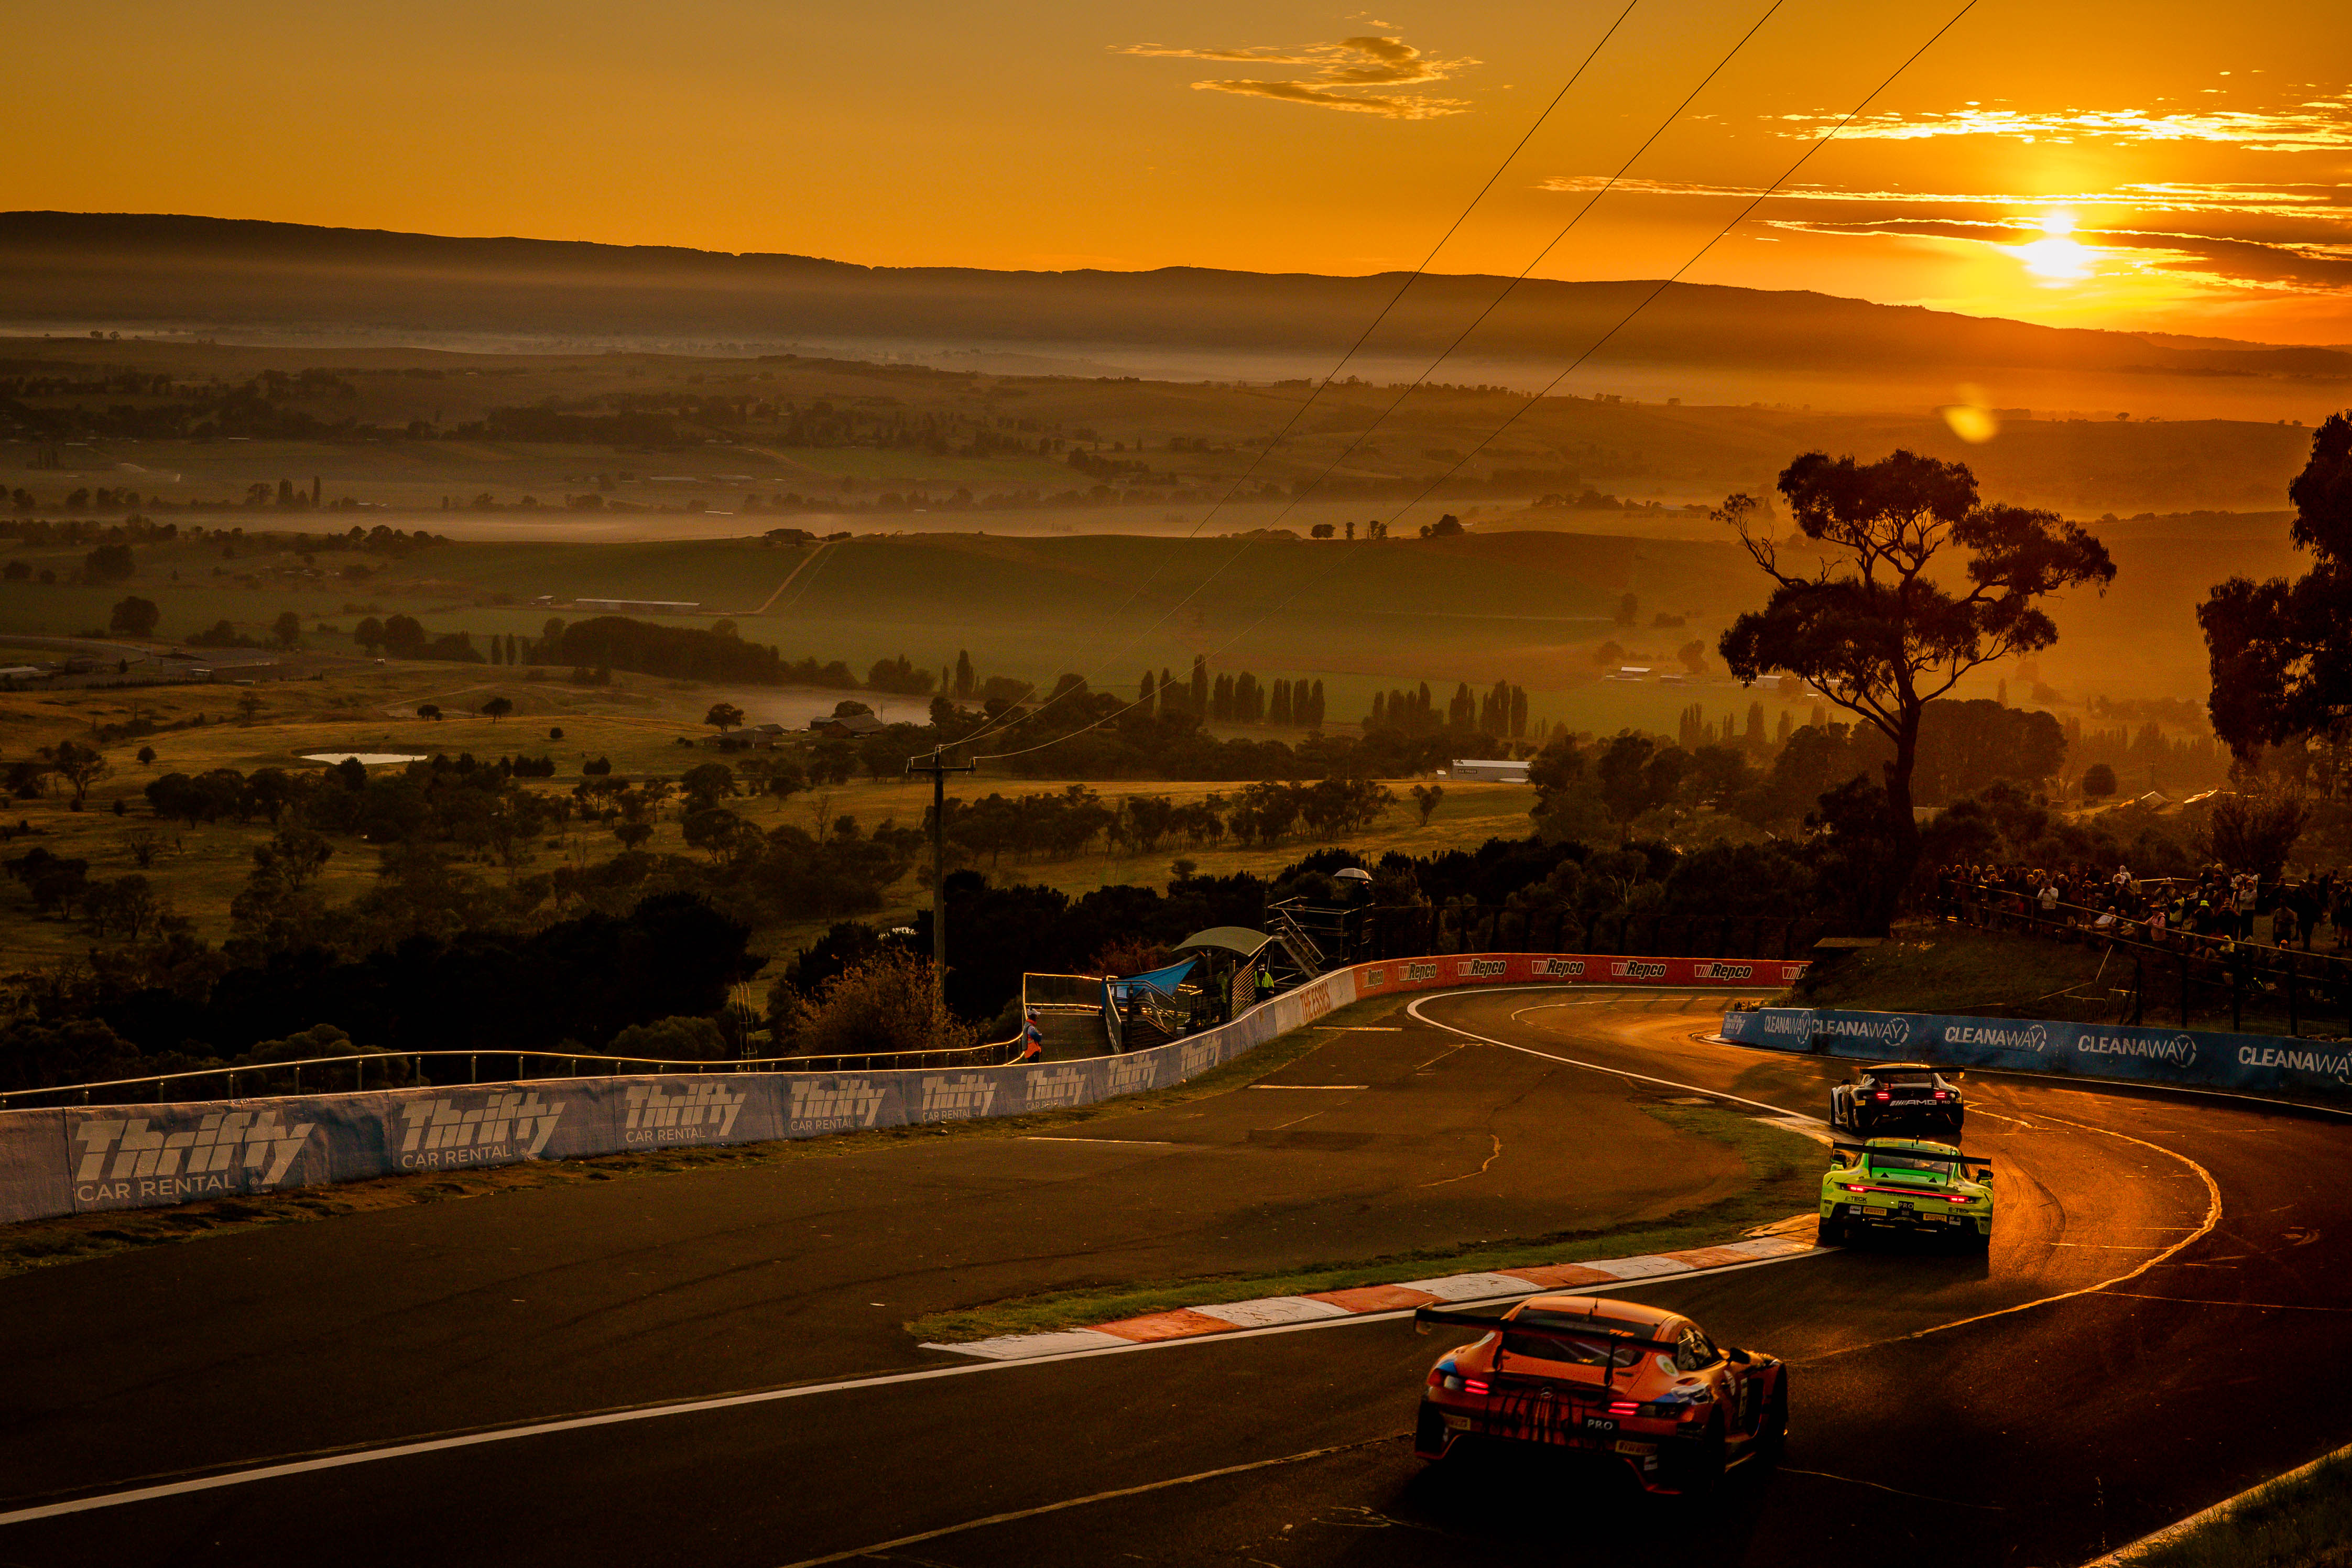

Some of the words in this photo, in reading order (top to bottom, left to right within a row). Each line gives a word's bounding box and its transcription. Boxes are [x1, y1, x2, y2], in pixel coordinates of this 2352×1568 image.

[1408, 963, 1436, 982] Repco
[1469, 959, 1506, 978] Repco
[1545, 958, 1584, 977] Repco
[1625, 960, 1667, 979] Repco
[1708, 962, 1752, 981] Repco
[1367, 968, 1384, 989] Repco
[1300, 990, 1313, 1021] THE
[1312, 982, 1330, 1016] ESSES
[1765, 1015, 1808, 1036] CLEANAWAY
[1809, 1019, 1903, 1039] CLEANAWAY
[1945, 1027, 2041, 1048] CLEANAWAY
[2078, 1035, 2189, 1061] CLEANAWAY
[1107, 1054, 1159, 1088] Thrifty
[2239, 1046, 2352, 1075] CLEANAWA
[922, 1074, 997, 1116] Thrifty
[1026, 1068, 1086, 1105] Thrifty
[626, 1083, 747, 1136] Thrifty
[791, 1080, 886, 1126] Thrifty
[1026, 1102, 1040, 1111] CAR
[401, 1092, 567, 1153] Thrifty
[791, 1120, 812, 1131] CAR
[816, 1118, 854, 1129] RENTAL
[922, 1112, 939, 1122] CAR
[942, 1109, 972, 1119] RENTAL
[626, 1129, 653, 1142] CAR
[658, 1127, 706, 1141] RENTAL
[75, 1111, 315, 1185] Thrifty
[401, 1152, 438, 1168] CAR
[446, 1144, 511, 1164] RENTAL
[77, 1183, 130, 1202] CAR
[141, 1174, 236, 1198] RENTAL
[1587, 1419, 1614, 1431] PRO
